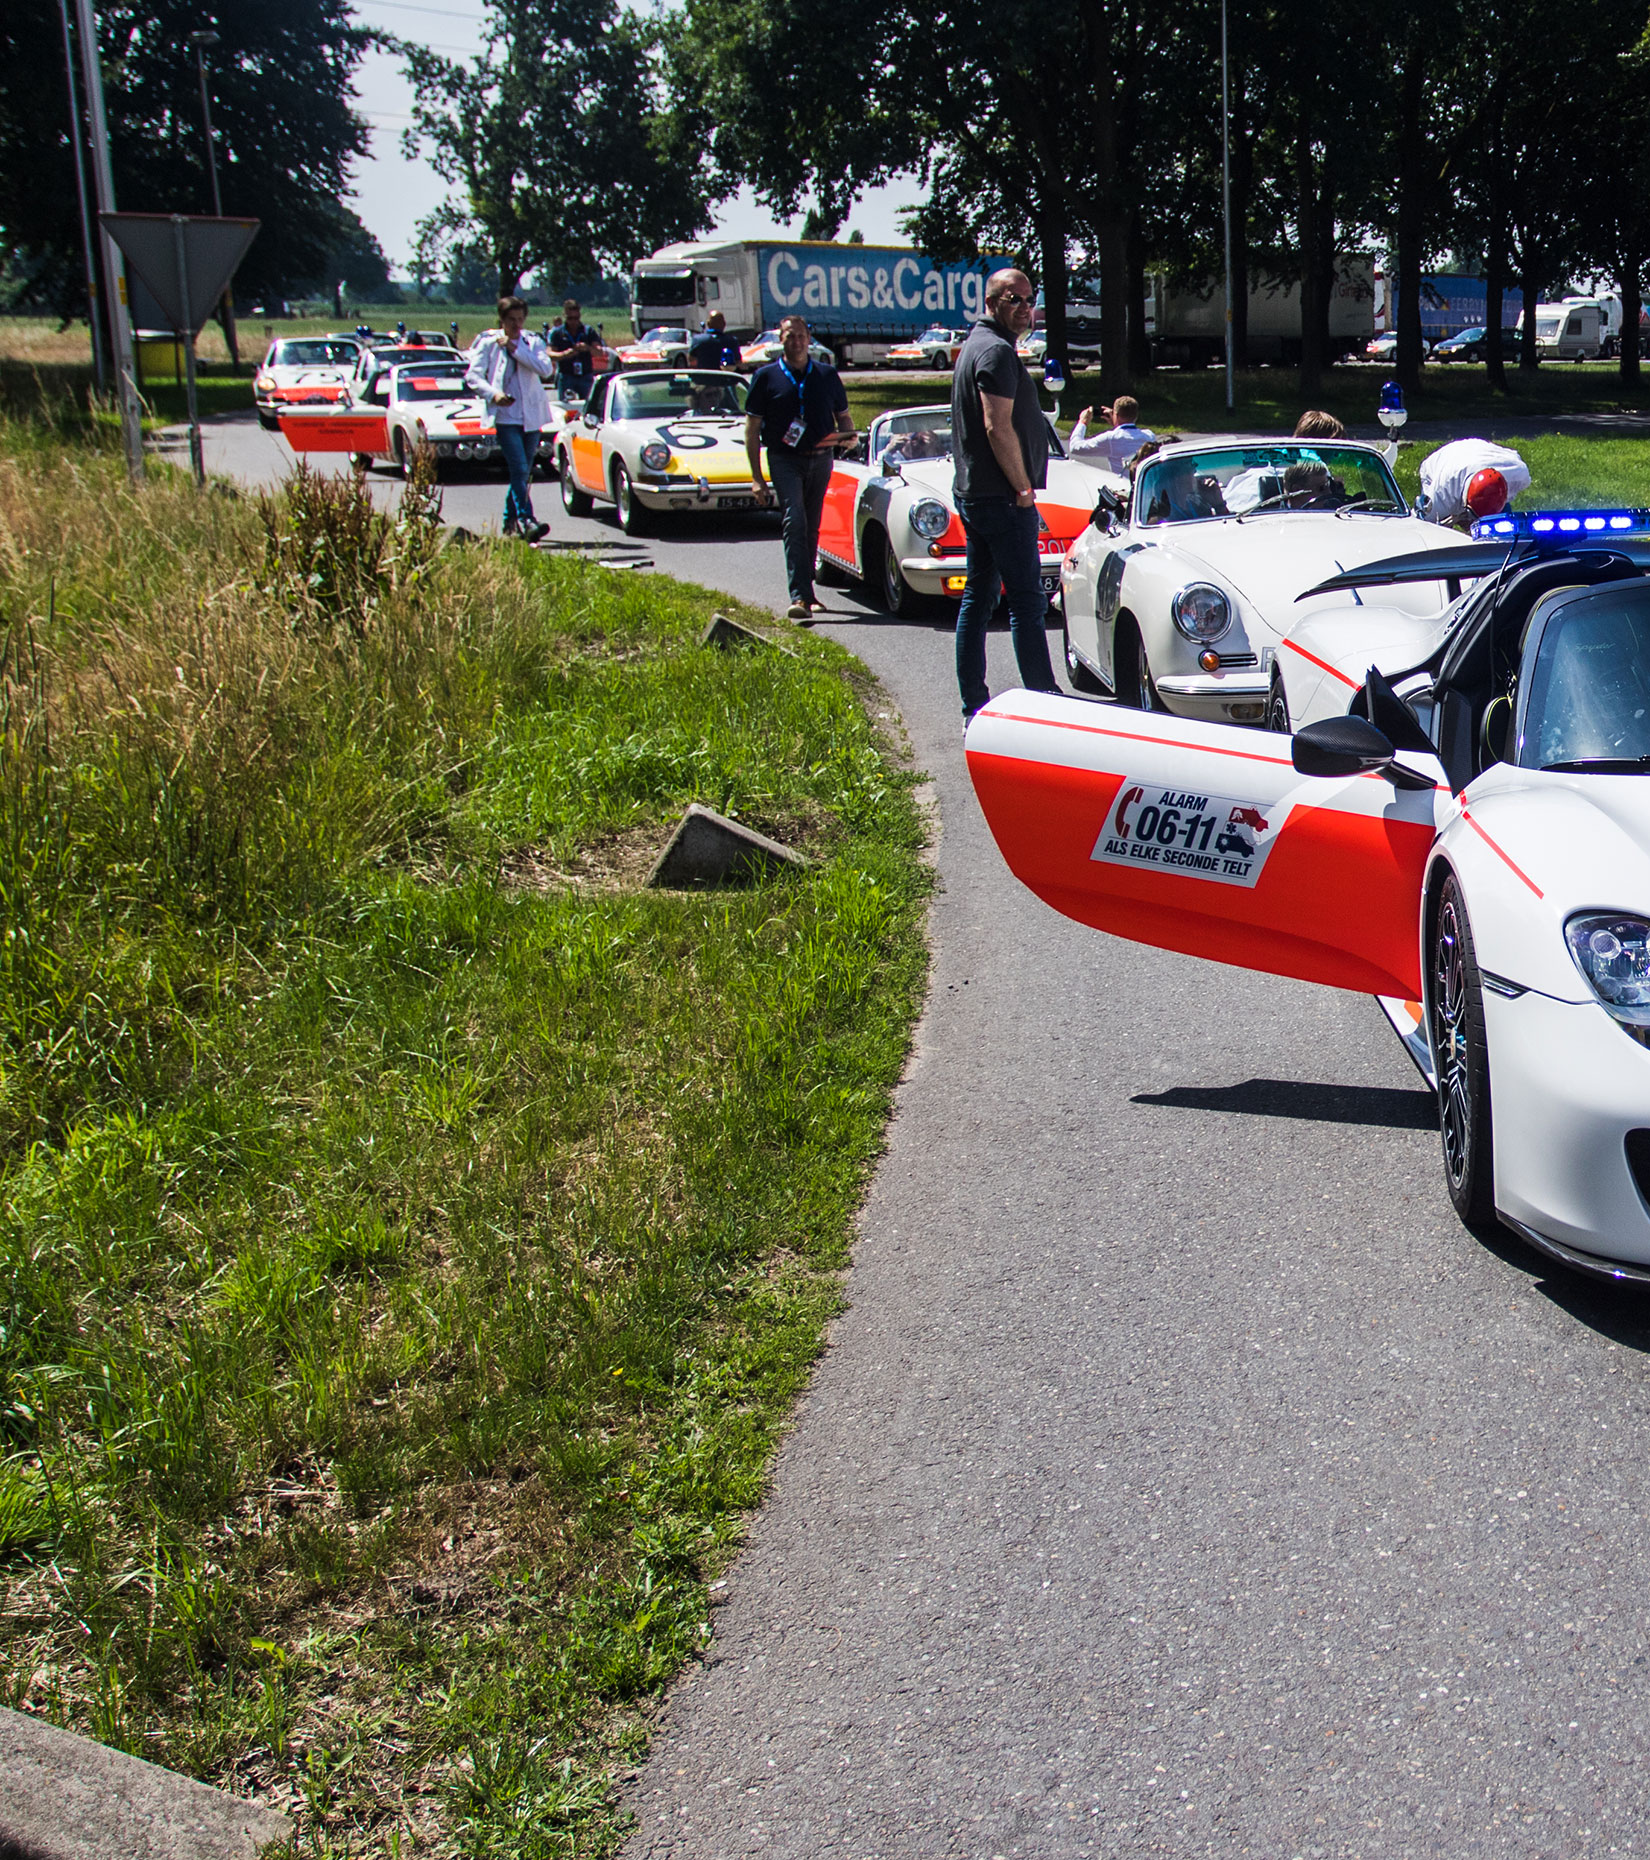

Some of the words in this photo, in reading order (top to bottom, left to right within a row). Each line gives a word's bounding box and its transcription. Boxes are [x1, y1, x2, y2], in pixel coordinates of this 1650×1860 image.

[768, 251, 983, 322] Cars&Carg
[1158, 791, 1209, 812] ALARM
[1135, 805, 1217, 851] 06-11
[1104, 839, 1128, 856] ALS
[1129, 844, 1161, 862] ELKE
[1162, 849, 1220, 872] SECONDE
[1222, 859, 1252, 877] TELT
